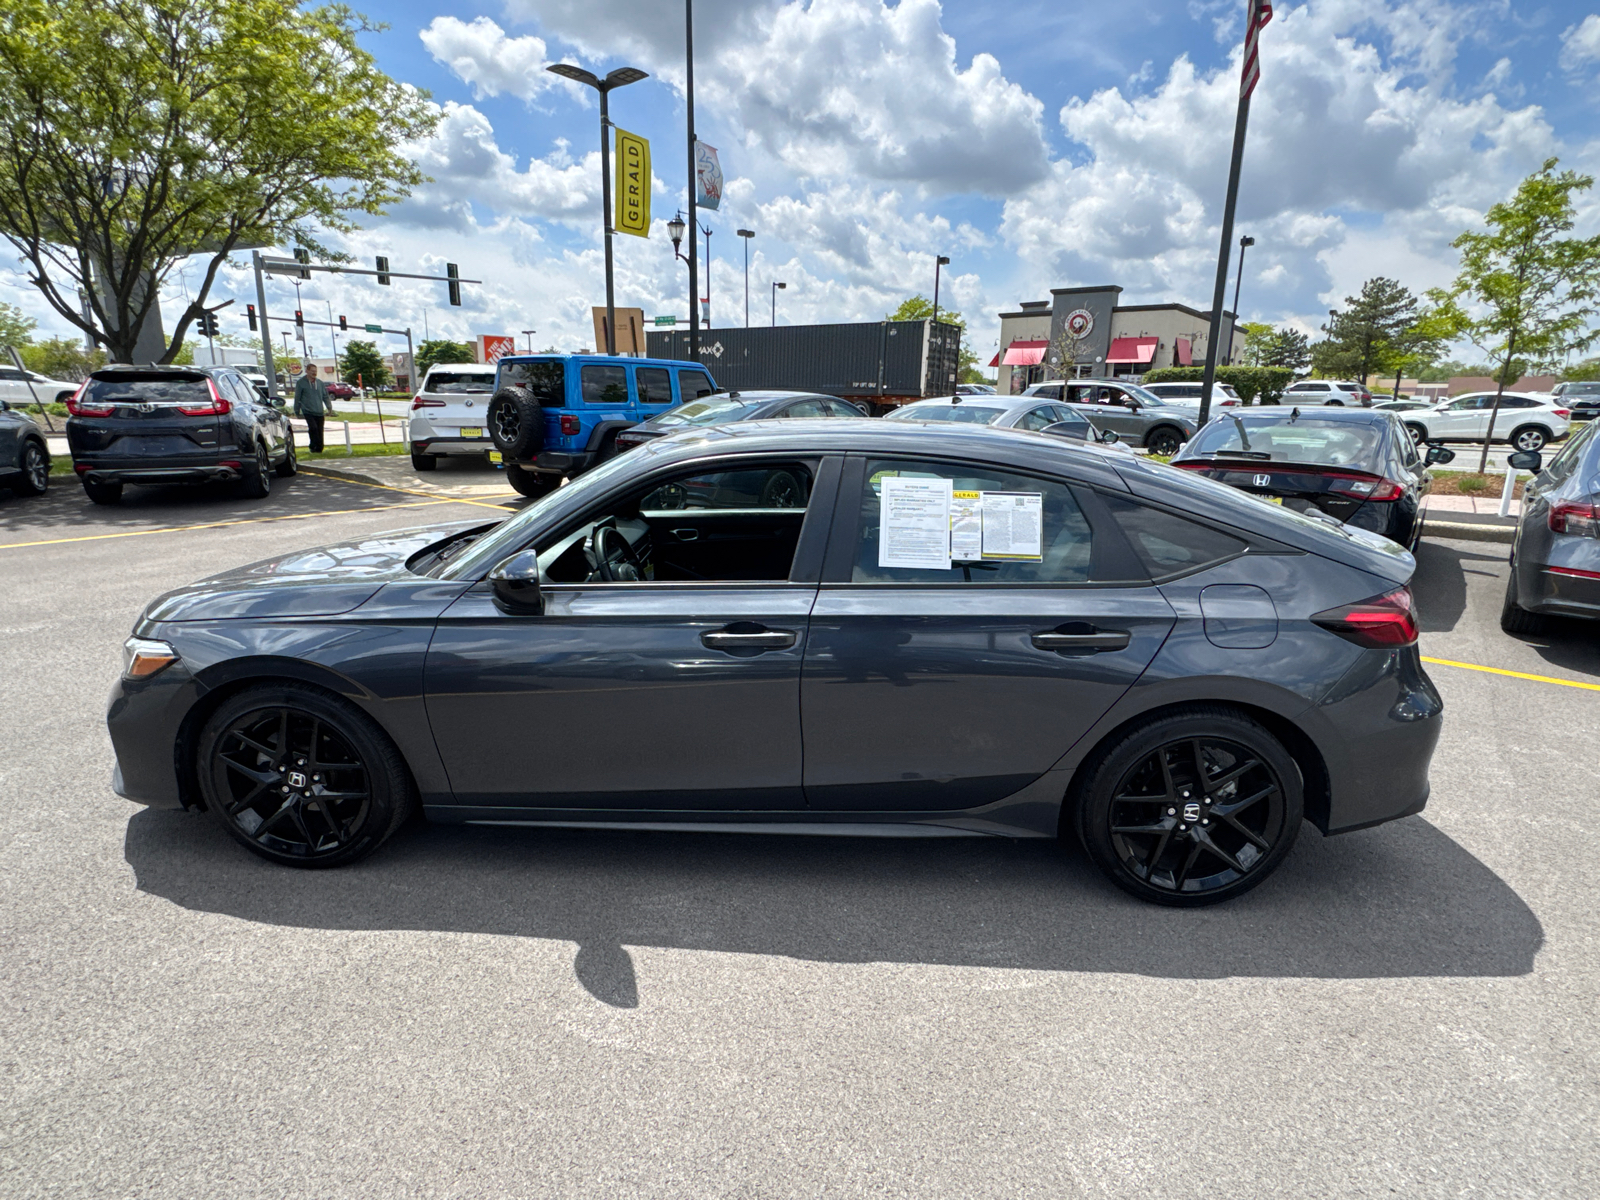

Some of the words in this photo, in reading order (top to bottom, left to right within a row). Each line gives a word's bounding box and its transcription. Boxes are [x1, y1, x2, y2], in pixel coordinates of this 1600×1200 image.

[697, 147, 721, 179] 250
[628, 146, 639, 221] GERALD
[487, 340, 500, 354] THE
